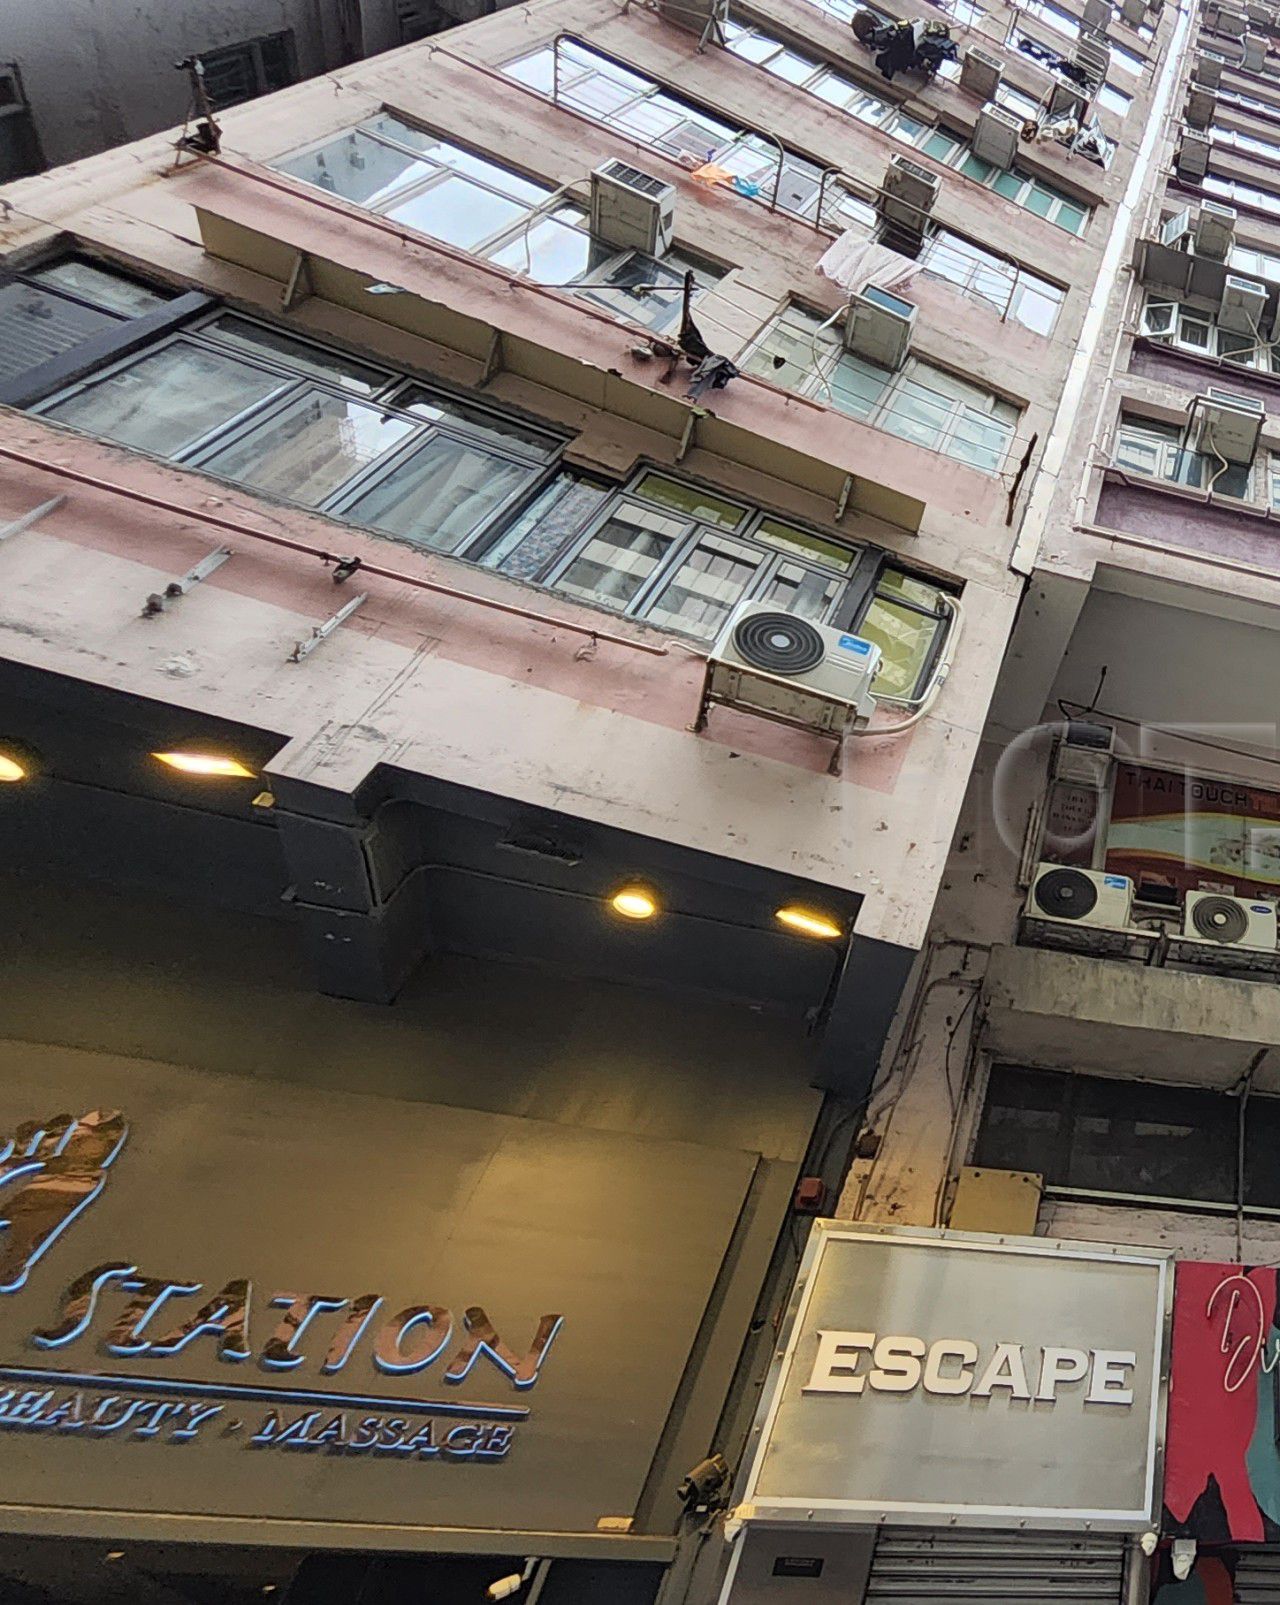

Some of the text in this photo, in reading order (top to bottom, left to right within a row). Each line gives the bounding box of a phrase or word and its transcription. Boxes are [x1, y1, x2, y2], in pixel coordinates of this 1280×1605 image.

[1126, 771, 1249, 808] THAI TOUCH
[33, 1261, 564, 1390] STATION
[804, 1330, 1136, 1406] ESCAPE
[251, 1407, 516, 1457] MASSAGE
